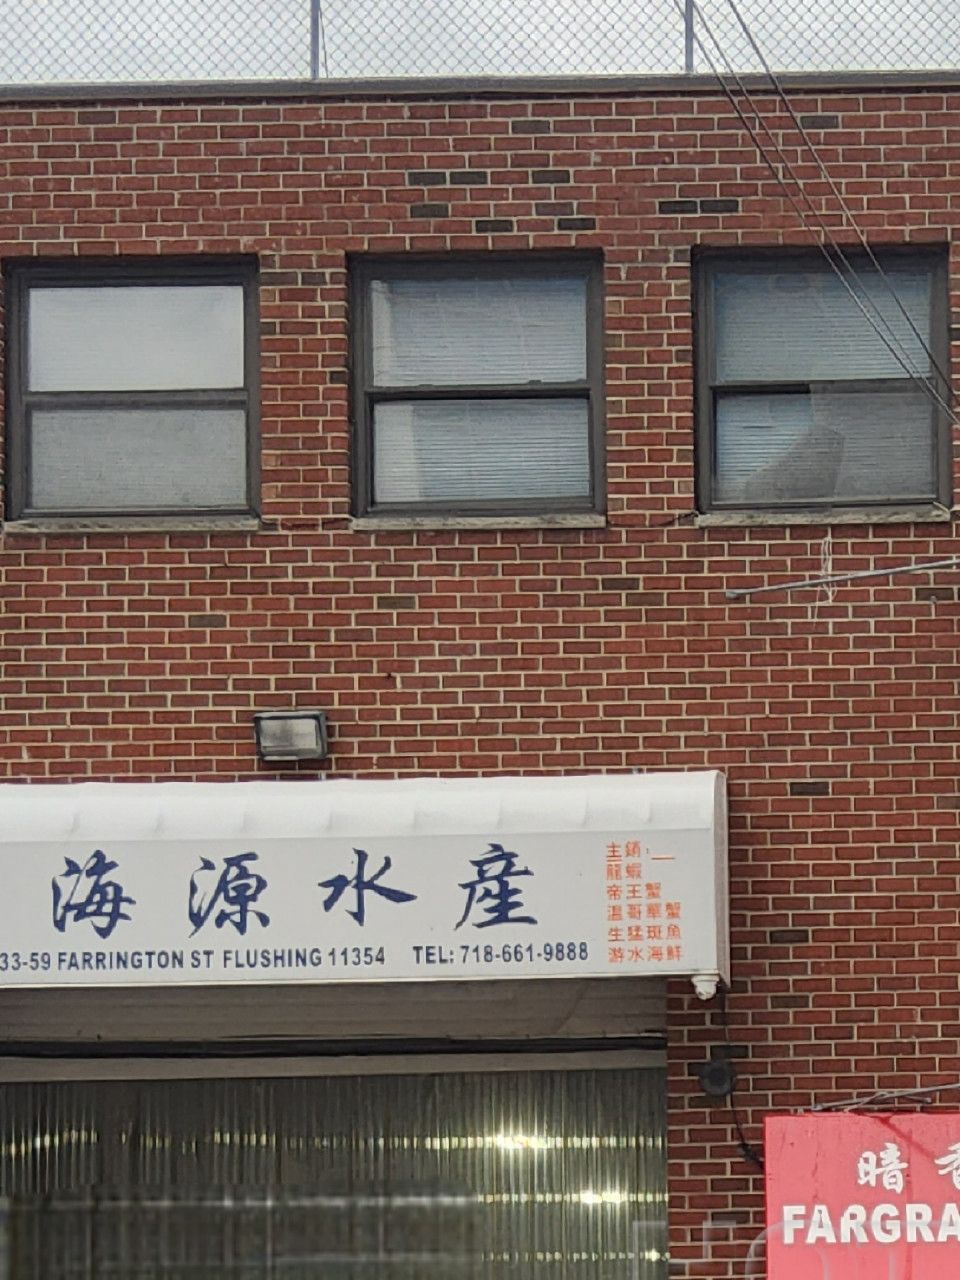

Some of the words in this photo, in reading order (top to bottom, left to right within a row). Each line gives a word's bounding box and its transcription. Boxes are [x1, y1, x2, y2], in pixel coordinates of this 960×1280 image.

[606, 882, 662, 900] 帝王蟹
[0, 951, 51, 971] 33-59
[57, 950, 184, 970] FARRINGTON
[190, 949, 214, 969] ST
[223, 947, 322, 968] FLUSHING
[328, 946, 386, 966] 11354
[412, 945, 454, 965] TEL:
[460, 942, 589, 965] 718-661-9888
